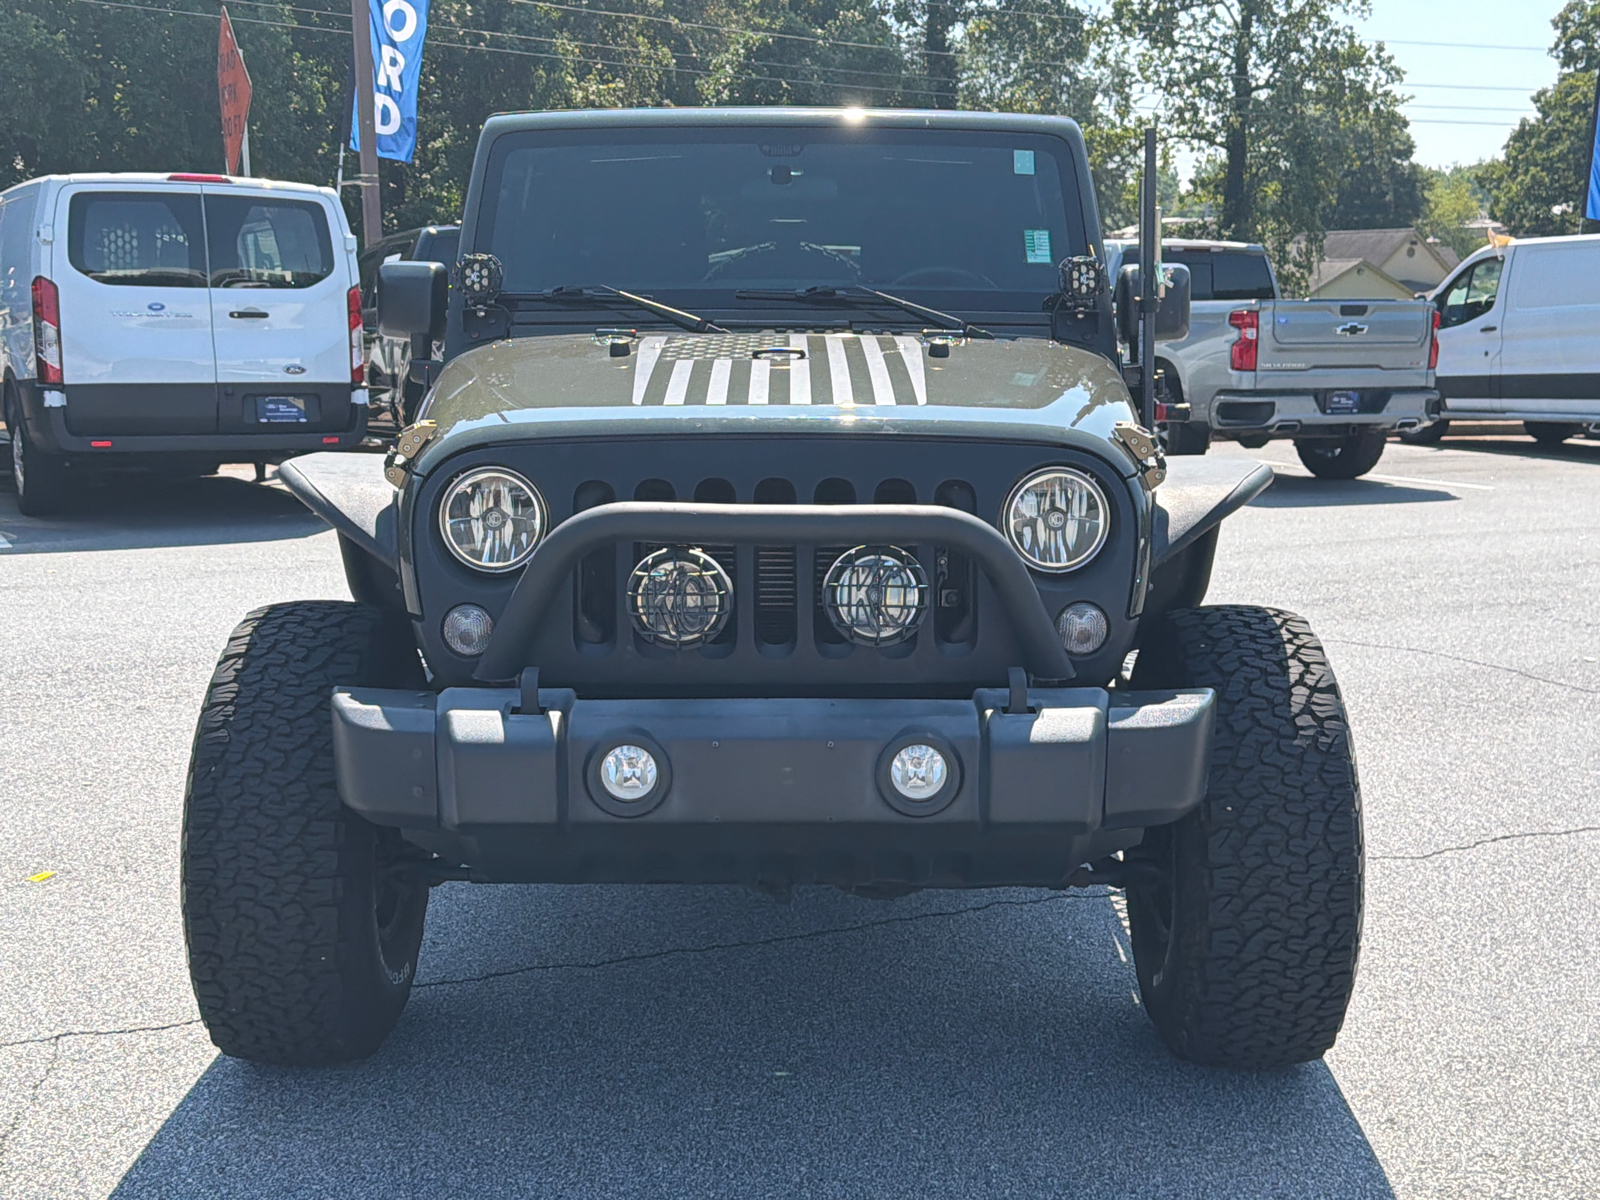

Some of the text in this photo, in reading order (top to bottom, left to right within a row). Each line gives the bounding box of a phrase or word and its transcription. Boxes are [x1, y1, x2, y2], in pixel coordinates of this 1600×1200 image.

[219, 50, 236, 74] OAD
[488, 513, 500, 526] KC
[1050, 513, 1063, 526] KC
